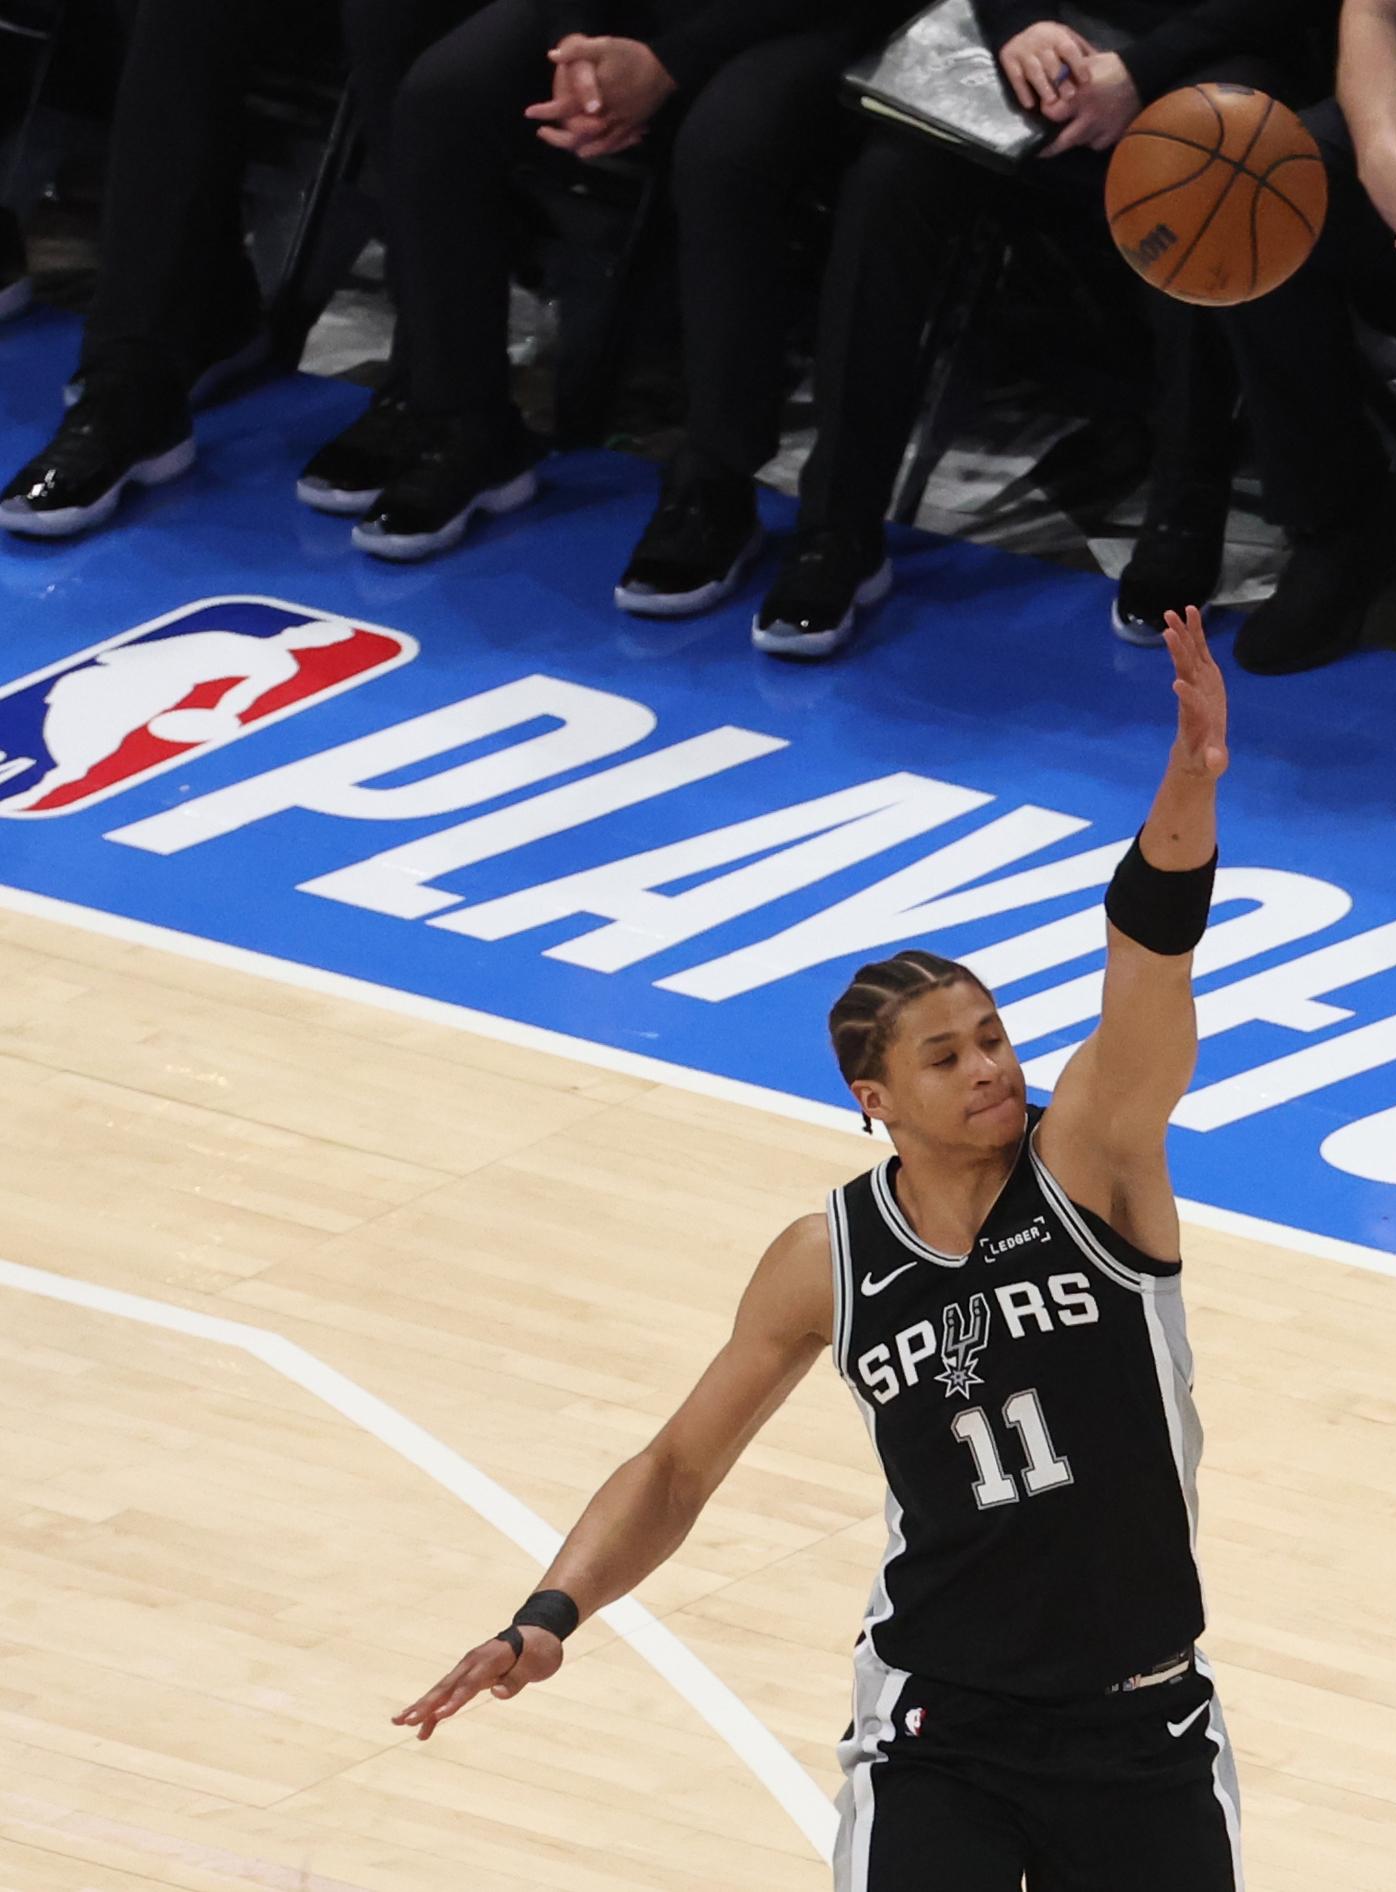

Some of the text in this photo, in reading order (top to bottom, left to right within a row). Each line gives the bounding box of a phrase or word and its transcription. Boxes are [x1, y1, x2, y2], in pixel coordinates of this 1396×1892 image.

[989, 1226, 1041, 1255] LEDGER
[857, 1271, 1099, 1404] SPURS
[950, 1387, 1074, 1510] 11
